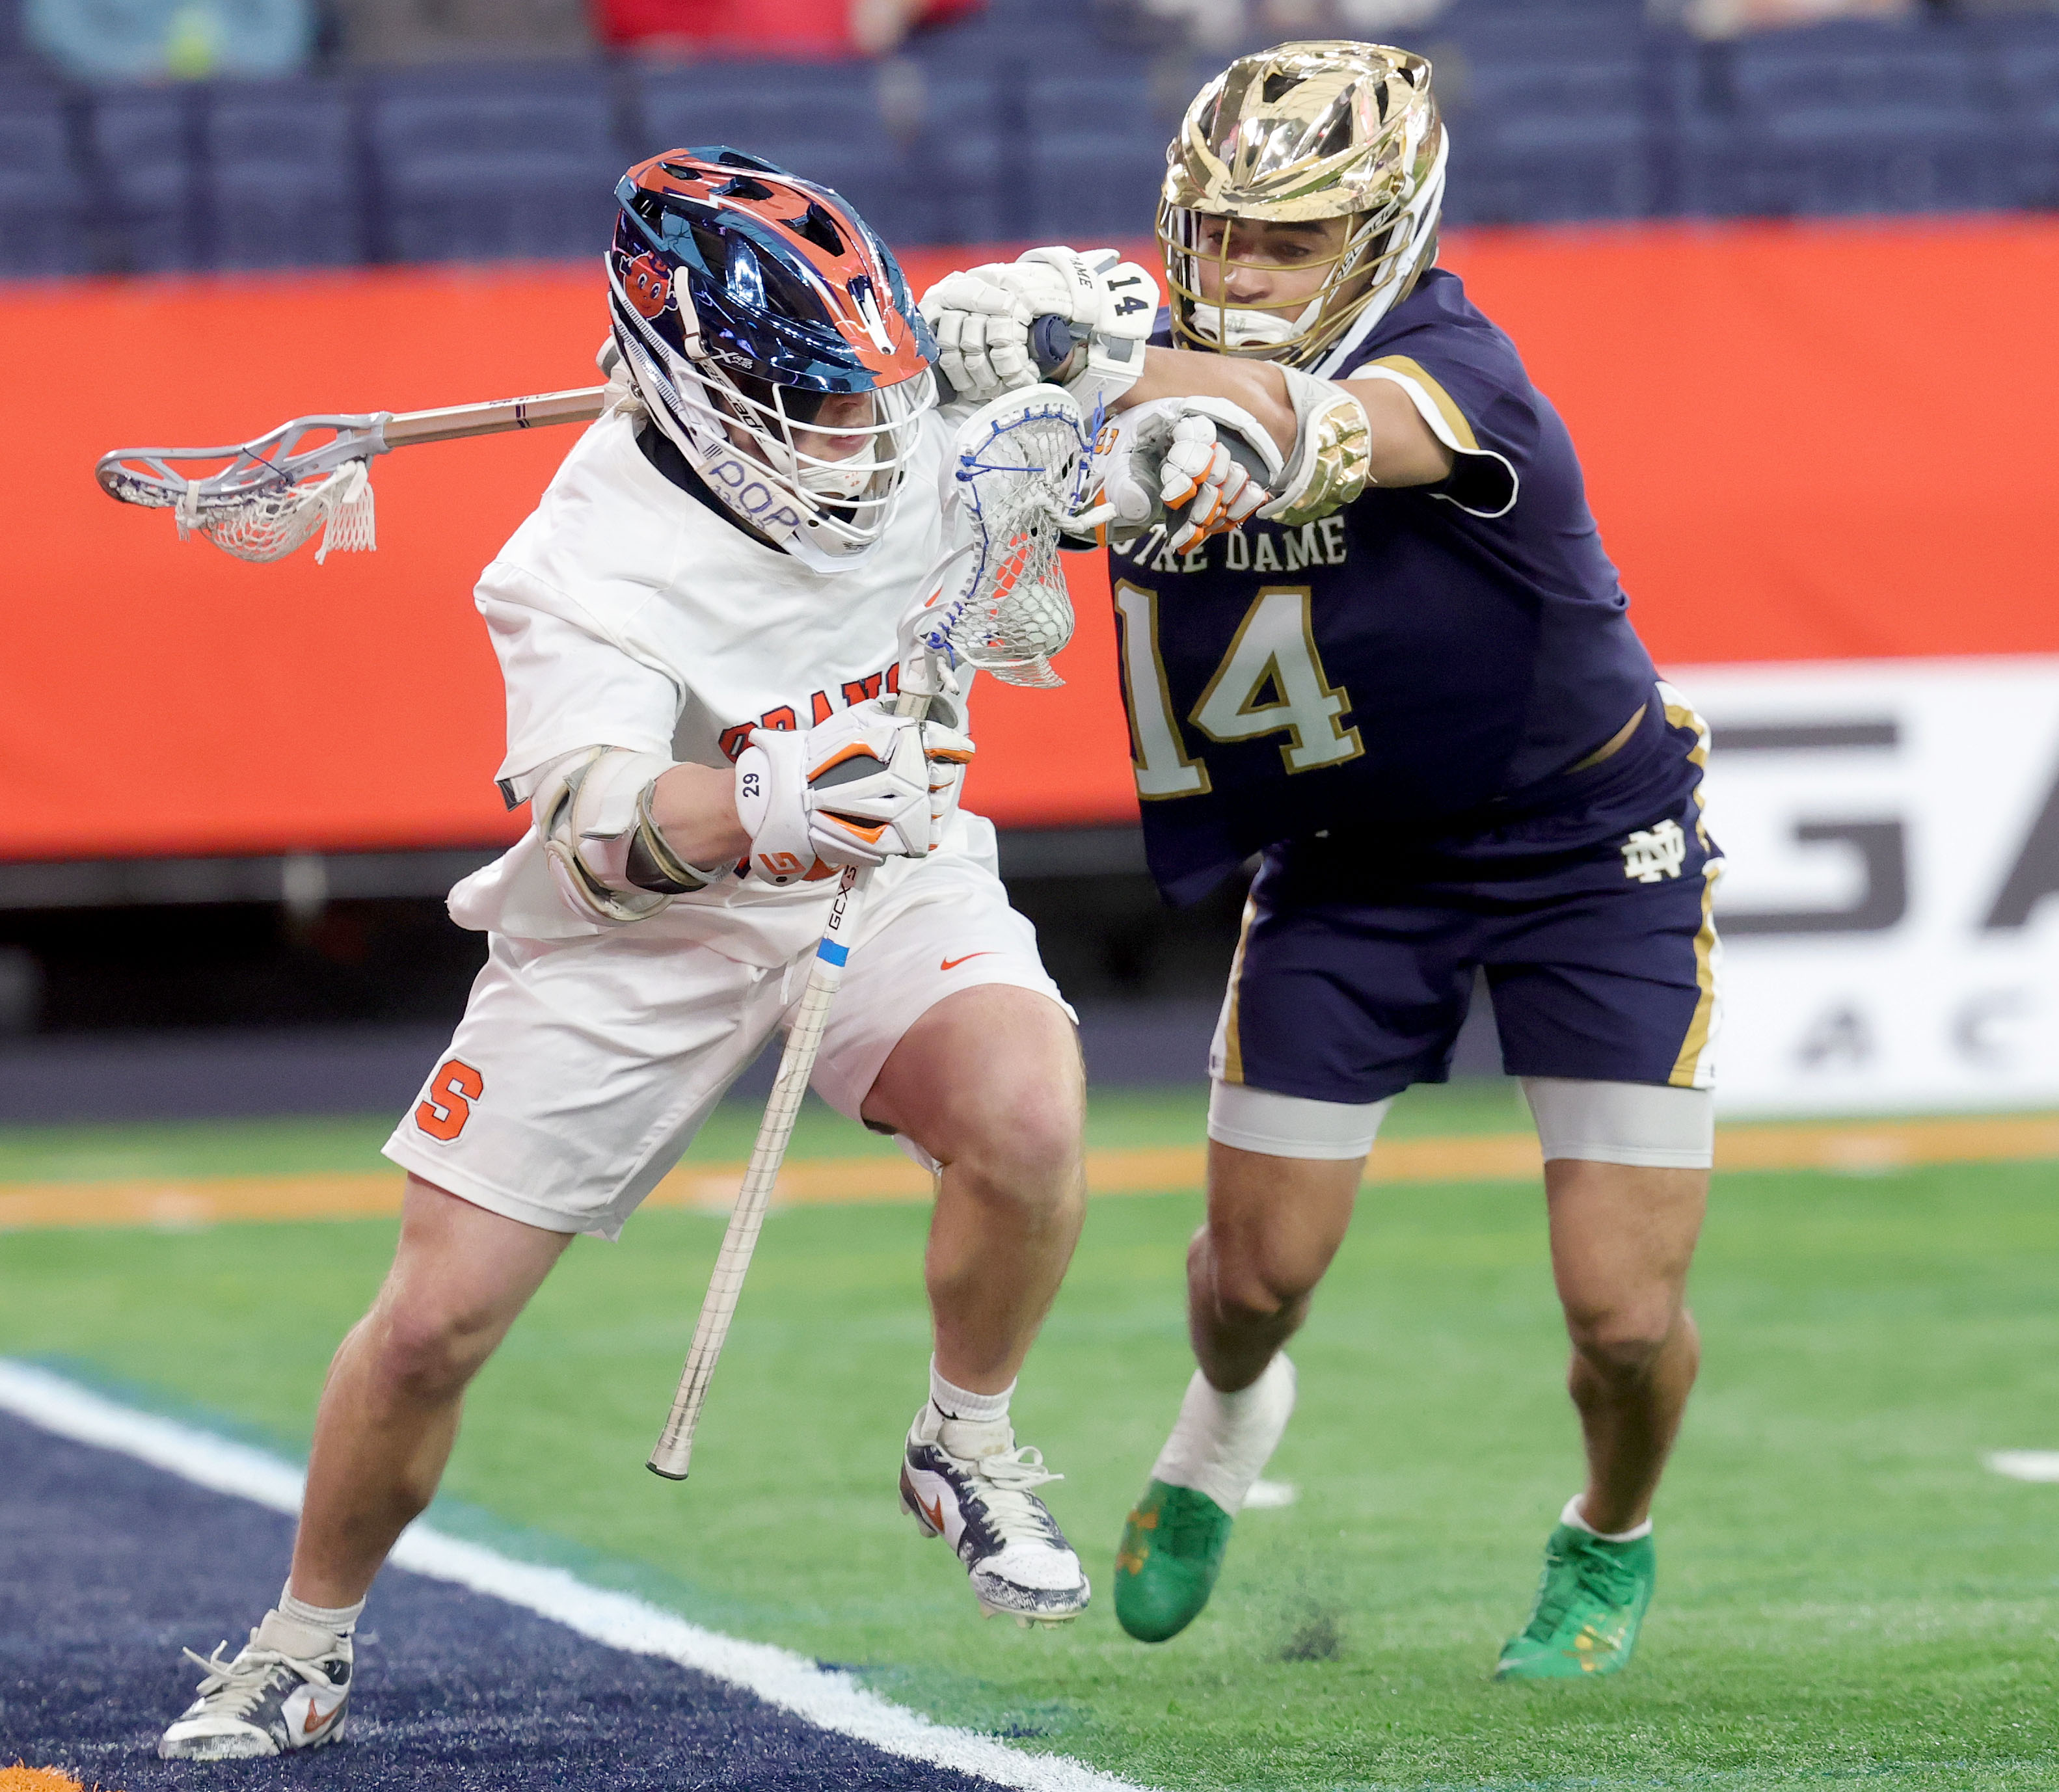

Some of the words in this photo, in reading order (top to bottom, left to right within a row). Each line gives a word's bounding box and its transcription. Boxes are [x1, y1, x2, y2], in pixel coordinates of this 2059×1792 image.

[1107, 276, 1150, 317] 14
[708, 460, 801, 527] POP
[1224, 514, 1347, 572] DAME
[1114, 577, 1366, 801] 14
[742, 773, 760, 798] 29
[414, 1058, 484, 1142] S
